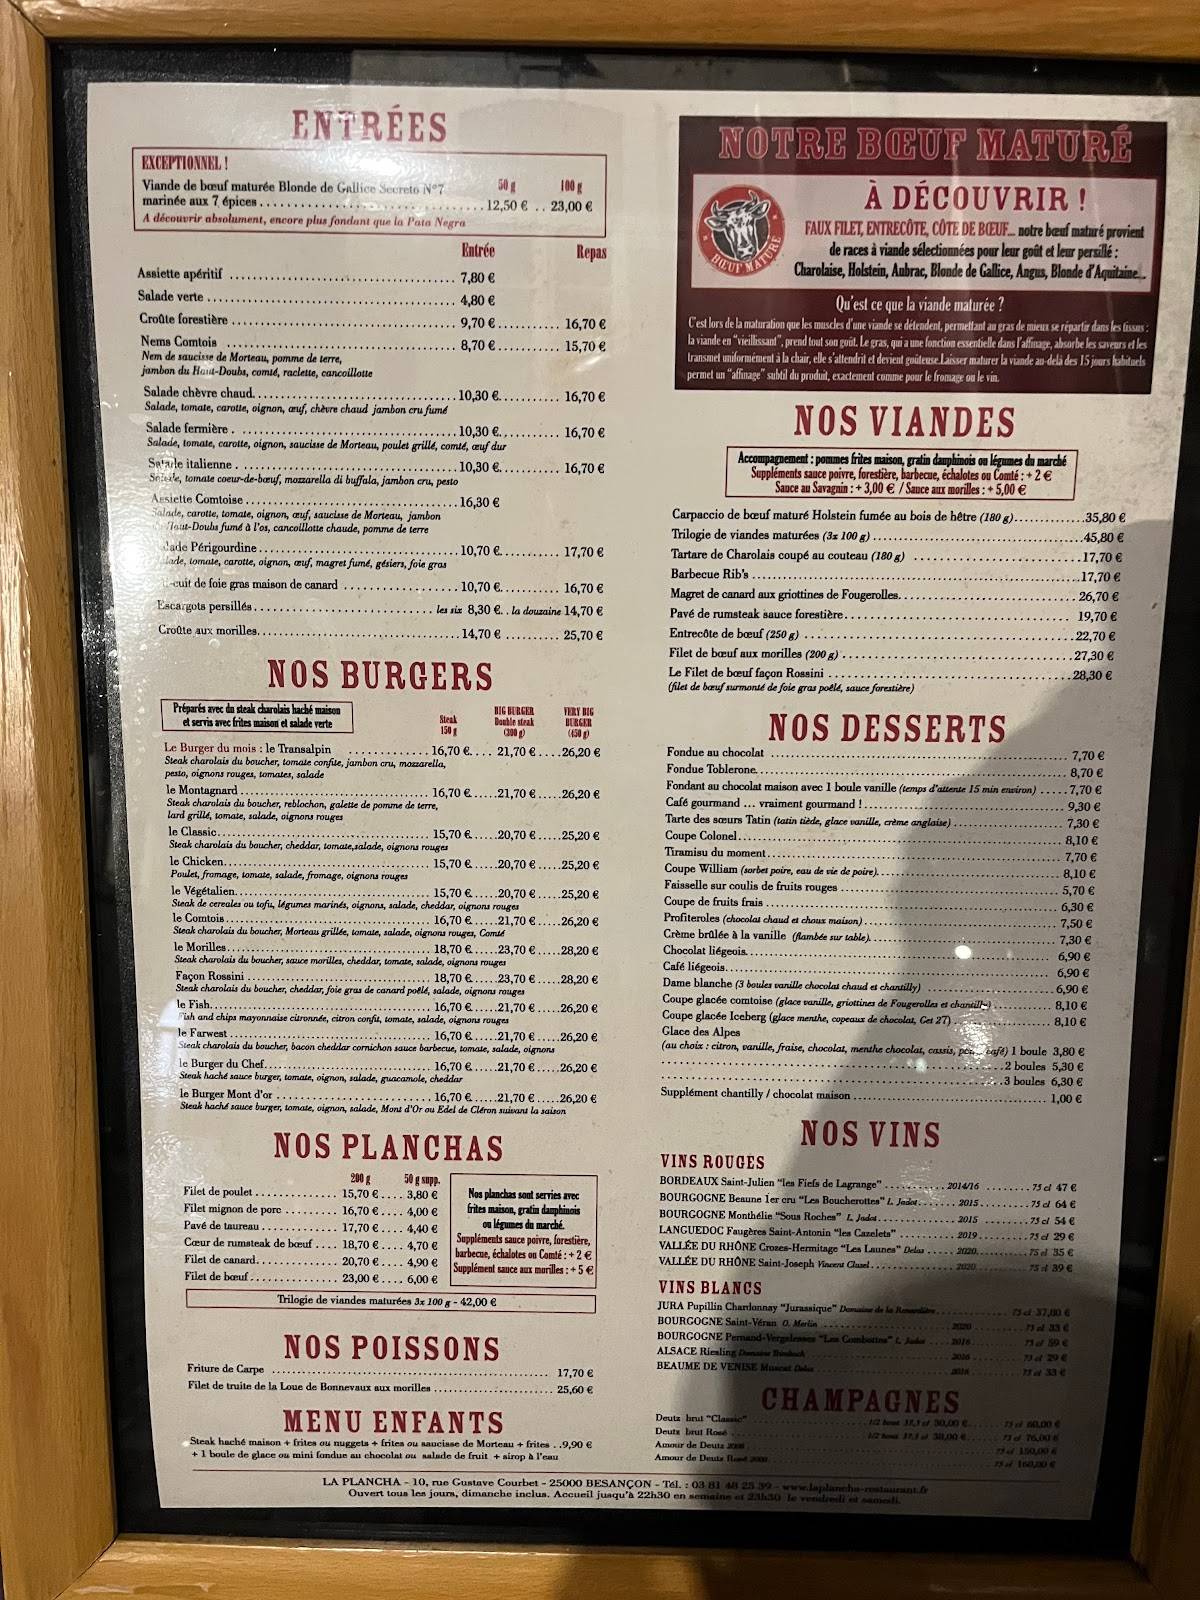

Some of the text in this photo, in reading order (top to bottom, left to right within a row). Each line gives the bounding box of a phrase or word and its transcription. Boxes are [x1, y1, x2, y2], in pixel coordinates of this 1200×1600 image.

[292, 105, 446, 142] ENTRÉES
[718, 125, 1132, 162] NOTRE BŒUF MATURÉ
[141, 155, 222, 170] EXCEPTIONNEL
[142, 178, 180, 191] Viande
[183, 179, 197, 191] de
[199, 179, 229, 191] bœuf
[231, 181, 275, 192] maturée
[278, 180, 317, 193] Blonde
[320, 181, 333, 193] de
[336, 182, 375, 193] Gallice
[864, 179, 1086, 211] À DÉCOUVRIR !
[805, 220, 831, 235] FAUX
[834, 220, 864, 237] FILET,
[866, 218, 929, 237] ENTRECÔTE,
[931, 218, 959, 236] CÔTE
[961, 221, 976, 236] DE
[1018, 224, 1043, 237] notre
[1045, 222, 1071, 237] bœuf
[1071, 223, 1104, 238] maturé
[1105, 224, 1144, 240] provient
[461, 242, 495, 257] Entrée
[576, 244, 607, 262] Repas
[137, 267, 495, 285] Assiette apéritif 7,80 €
[793, 261, 846, 278] Charolaise,
[847, 261, 889, 278] Holstein,
[891, 262, 928, 279] Aubrac,
[930, 262, 963, 278] Blonde
[965, 262, 977, 278] de
[979, 262, 1014, 279] Gallice,
[1015, 263, 1048, 280] Angus,
[1050, 263, 1084, 278] Blonde
[138, 289, 495, 307] Salade verte 4,80 €
[835, 294, 1004, 314] Qu'est ce que la viande maturée ?
[144, 400, 178, 412] Salade,
[180, 403, 214, 413] tomate,
[216, 404, 249, 413] carotte,
[251, 403, 285, 415] oignon,
[288, 403, 307, 416] œuf,
[310, 403, 338, 413] chèvre
[340, 403, 369, 414] chaud
[371, 404, 406, 416] jambon
[422, 404, 448, 416] fumé
[793, 405, 1014, 437] NOS VIANDES
[671, 567, 720, 579] Barbecue
[1081, 571, 1111, 583] 17,70
[1113, 572, 1121, 582] €
[669, 627, 1116, 642] Entrecôte de bœuf (250 g) 22,70 €
[267, 659, 492, 690] NOS BURGERS
[768, 713, 1005, 743] NOS DESSERTS
[164, 741, 177, 752] Le
[180, 742, 214, 756] Burger
[216, 742, 229, 753] du
[233, 743, 256, 753] mois
[265, 742, 275, 753] le
[277, 743, 331, 756] Transalpin
[431, 745, 460, 757] 16,70
[462, 745, 471, 756] €
[497, 746, 526, 758] 21,70
[528, 746, 536, 757] €
[561, 747, 591, 758] 26,20
[593, 747, 600, 757] €
[666, 746, 704, 757] Fondue
[722, 746, 764, 757] chocolat
[1072, 750, 1095, 762] 7,70
[1097, 750, 1105, 761] €
[663, 895, 1094, 913] Coupe de fruits frais 6,30 €
[800, 1120, 939, 1147] NOS VINS
[273, 1132, 502, 1161] NOS PLANCHAS
[660, 1153, 764, 1169] VINS ROUGES
[183, 1185, 438, 1200] Filet de poulet 15,70 € 3,80 €
[659, 1225, 831, 1238] LANGUEDOC Faugères Saint-Antonin
[658, 1255, 814, 1270] VALLÉE DU RHÔNE Saint-Joseph
[658, 1279, 761, 1295] VINS BLANCS
[657, 1316, 723, 1326] BOURGOGNE
[781, 1319, 791, 1327] O.
[283, 1334, 499, 1361] NOS POISSONS
[187, 1363, 593, 1378] Friture de Carpe 17,70 €
[761, 1387, 959, 1413] CHAMPAGNES
[282, 1409, 503, 1434] MENU ENFANTS
[322, 1477, 339, 1486] LA
[341, 1477, 401, 1486] PLANCHA
[413, 1477, 429, 1487] 10,
[451, 1477, 494, 1486] Gustave
[497, 1478, 538, 1487] Courbet
[549, 1478, 583, 1487] 25000
[586, 1479, 652, 1489] BESANÇON
